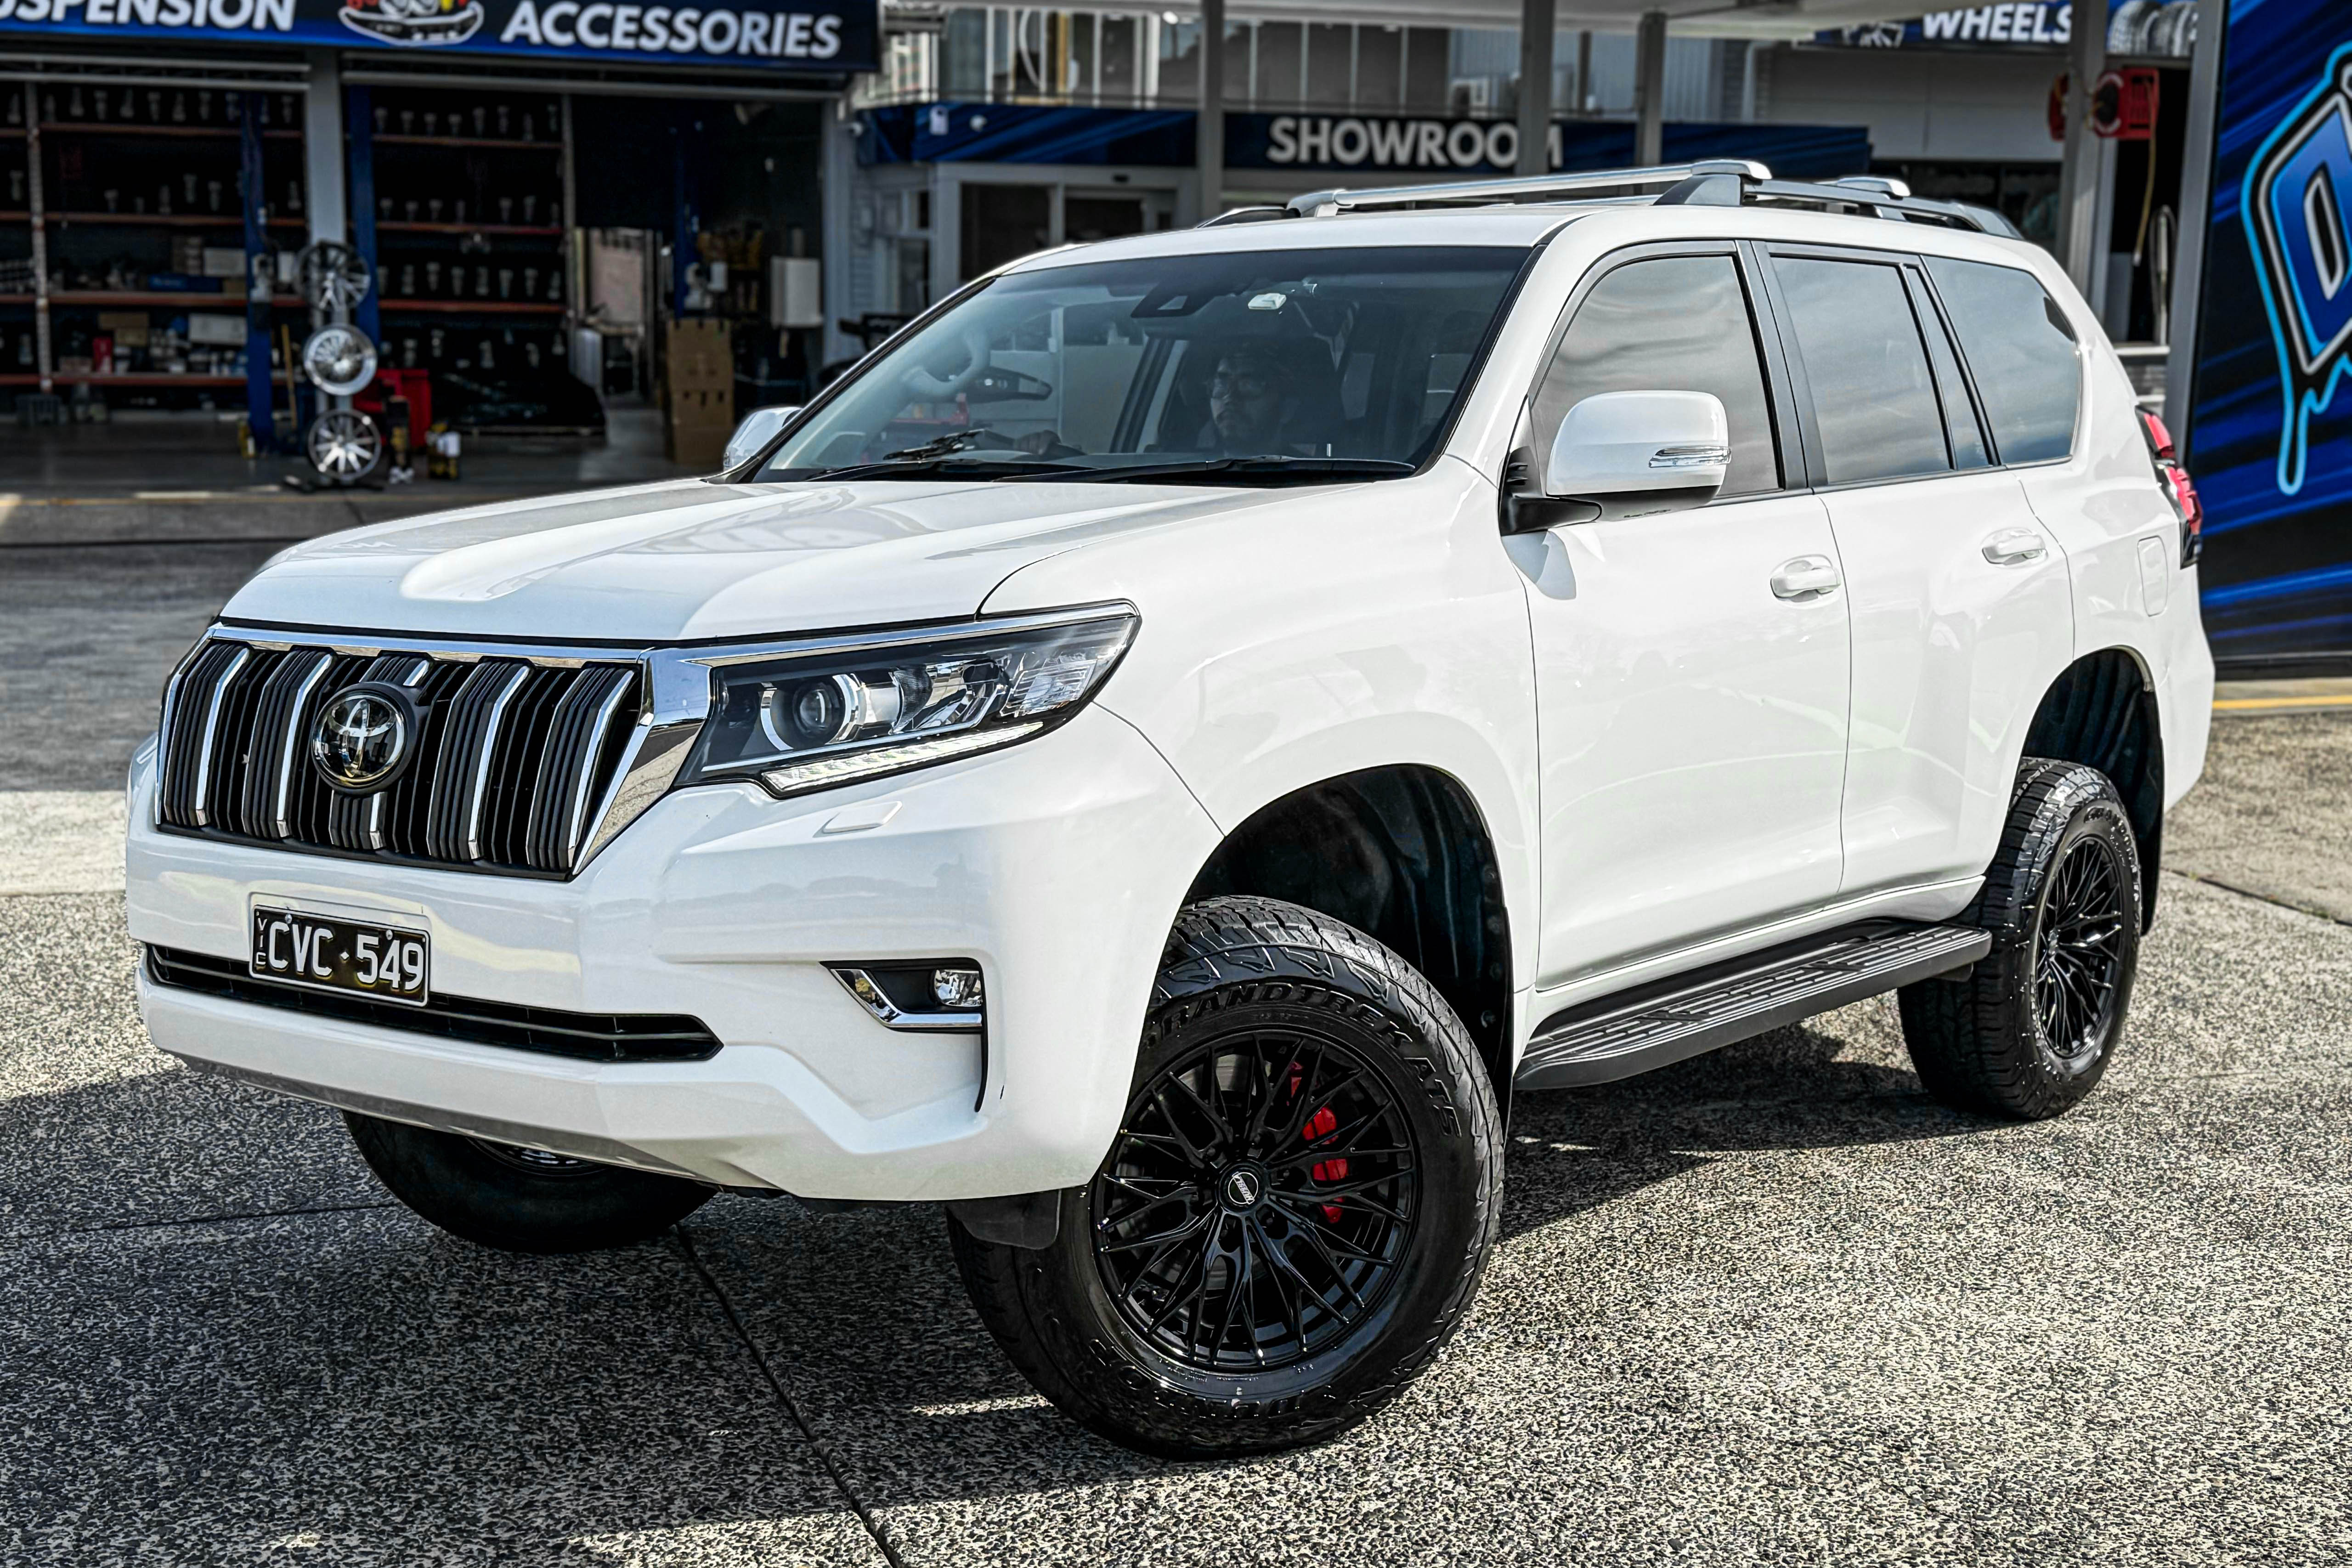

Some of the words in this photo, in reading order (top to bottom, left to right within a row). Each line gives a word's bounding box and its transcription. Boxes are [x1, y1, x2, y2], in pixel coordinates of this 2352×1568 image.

[0, 0, 295, 31] SPENSION
[500, 0, 842, 58] ACCESSORIES
[1923, 3, 2072, 43] WHEELS
[256, 917, 267, 966] VIC
[269, 921, 334, 976] CVC
[356, 934, 424, 991] 549
